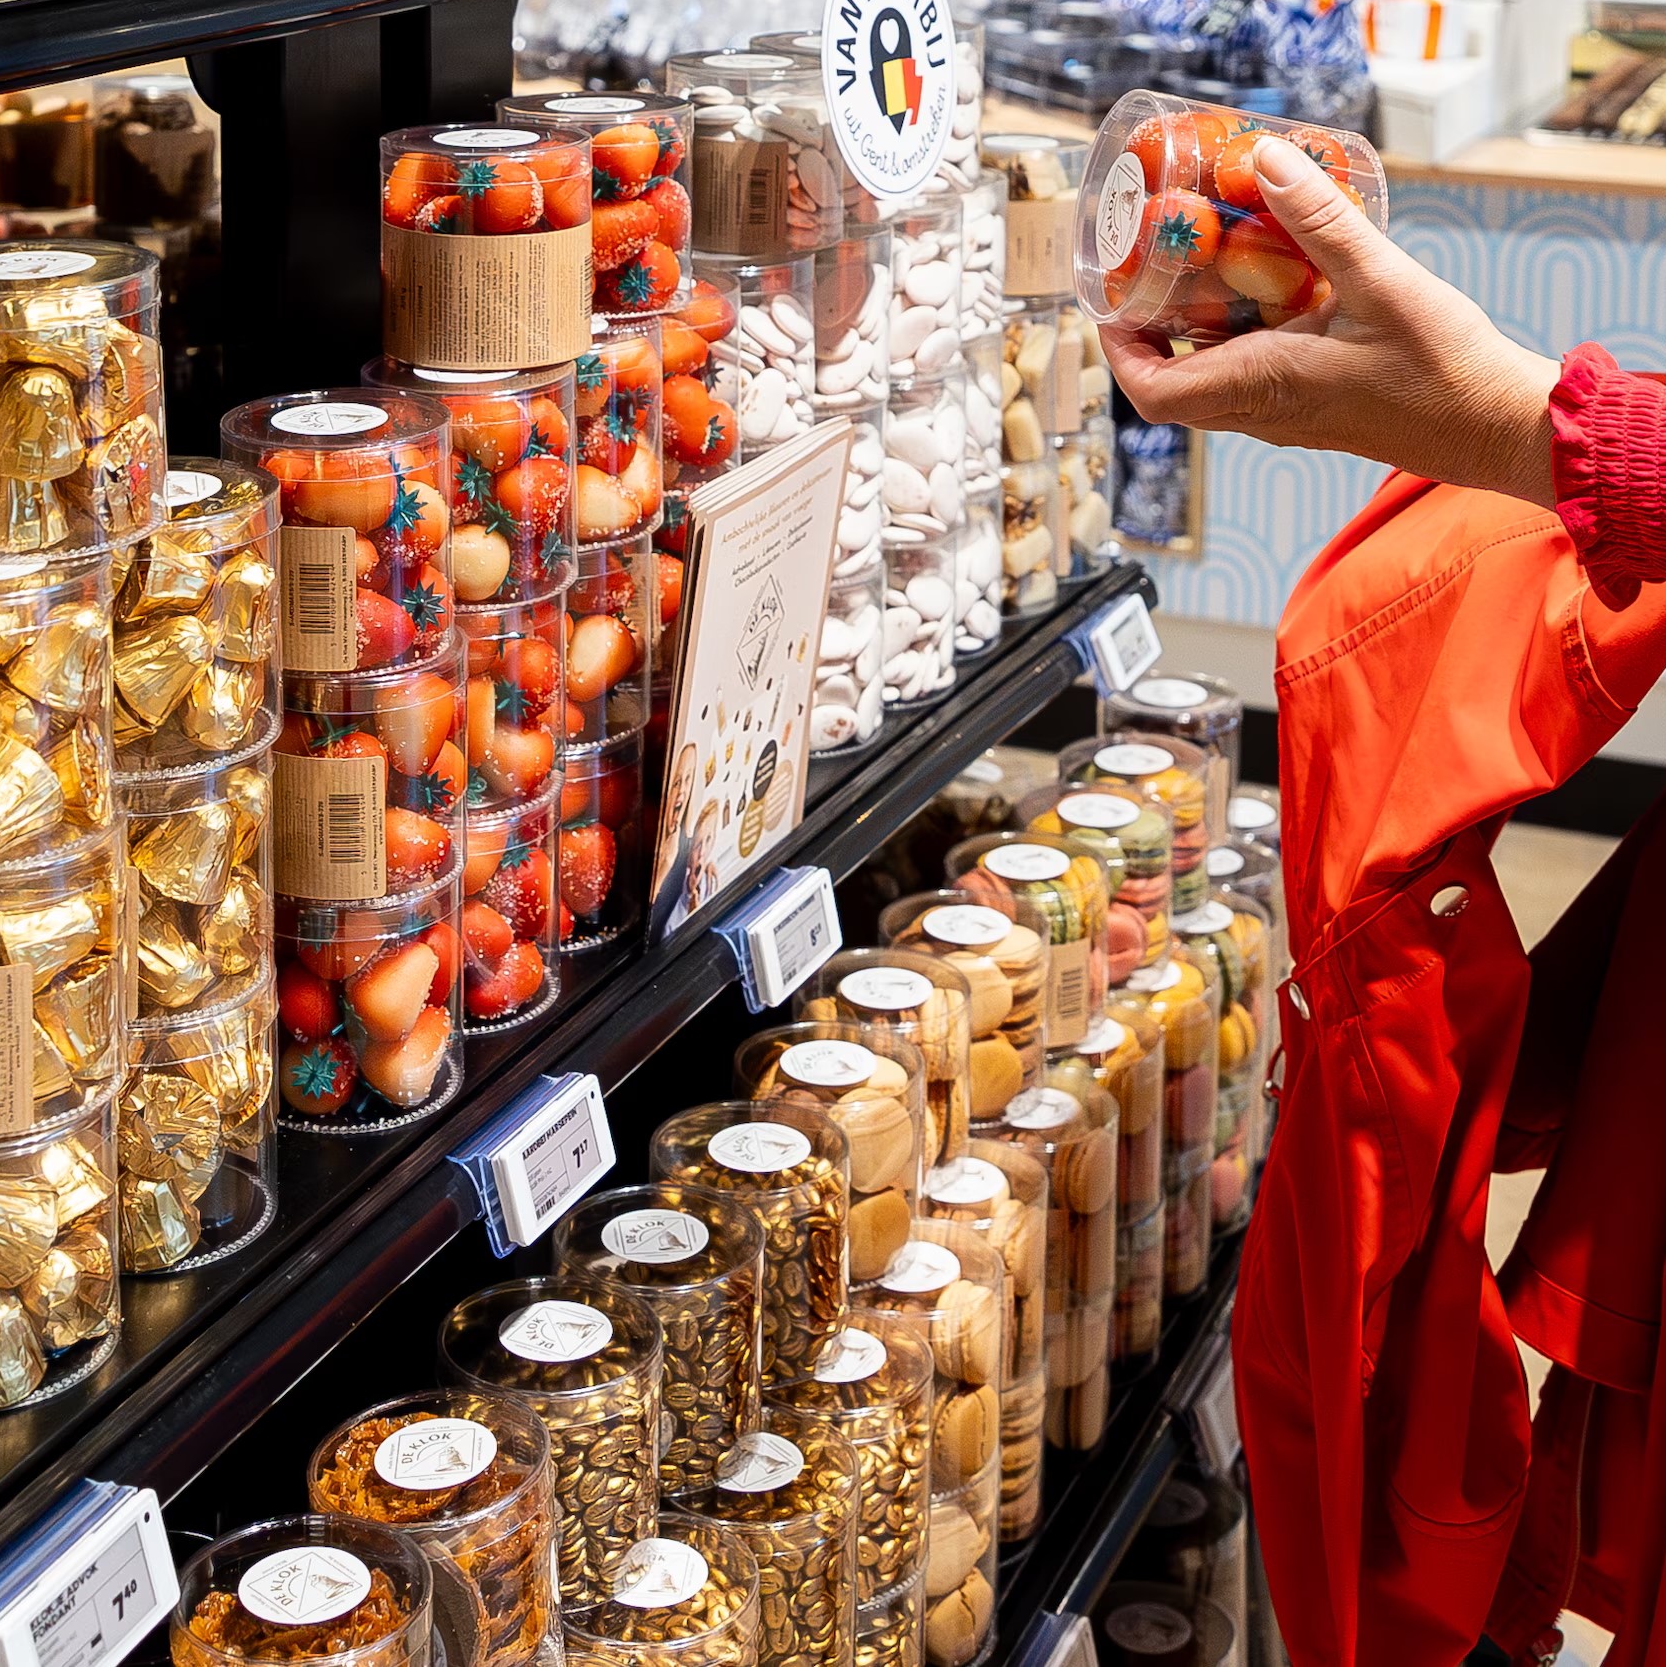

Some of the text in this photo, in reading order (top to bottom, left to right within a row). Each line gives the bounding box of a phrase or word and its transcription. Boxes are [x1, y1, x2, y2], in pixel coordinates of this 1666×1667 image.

[844, 83, 946, 176] uit Gent & omstreken
[630, 1220, 665, 1234] KLOK
[401, 1451, 414, 1465] DE
[409, 1432, 452, 1450] KLOK
[66, 1560, 98, 1598] ADVOK
[270, 1564, 302, 1606] DE KLOK
[33, 1595, 76, 1643] FONDANT
